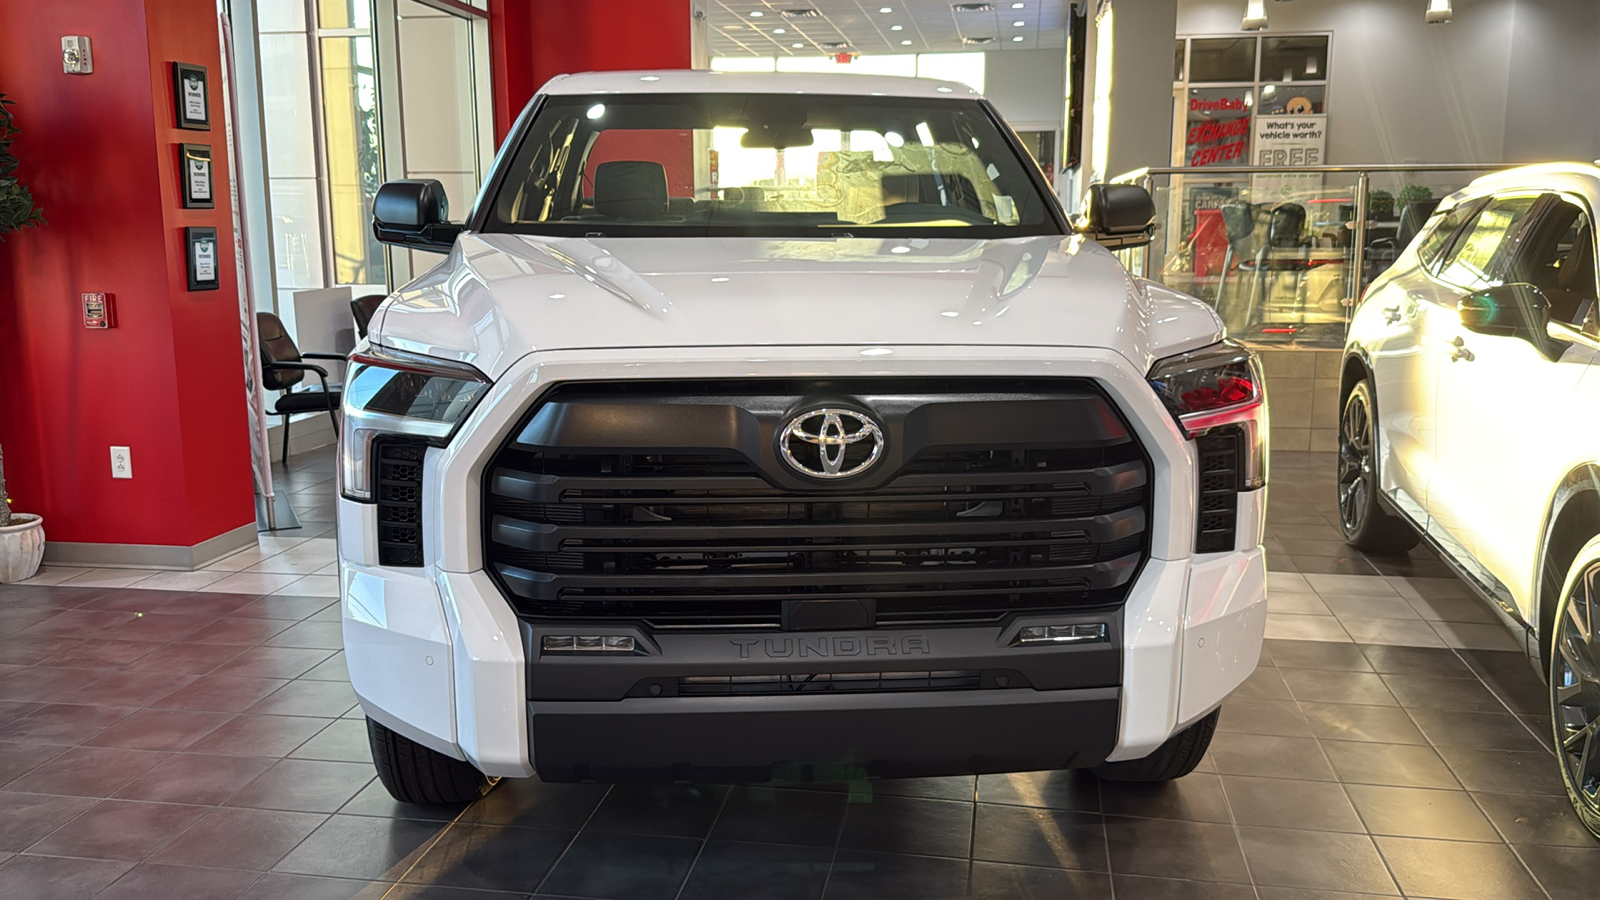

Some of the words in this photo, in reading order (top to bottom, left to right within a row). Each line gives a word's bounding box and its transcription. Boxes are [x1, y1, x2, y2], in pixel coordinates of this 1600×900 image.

[1190, 98, 1248, 112] DriveBaby
[1188, 118, 1249, 144] EXCHANGE
[1260, 131, 1290, 139] vehicle
[1293, 131, 1322, 139] worth?
[1191, 142, 1243, 166] CENTER
[1259, 148, 1319, 166] FREE
[84, 295, 103, 303] FIRE
[728, 634, 931, 659] TUNDRA
